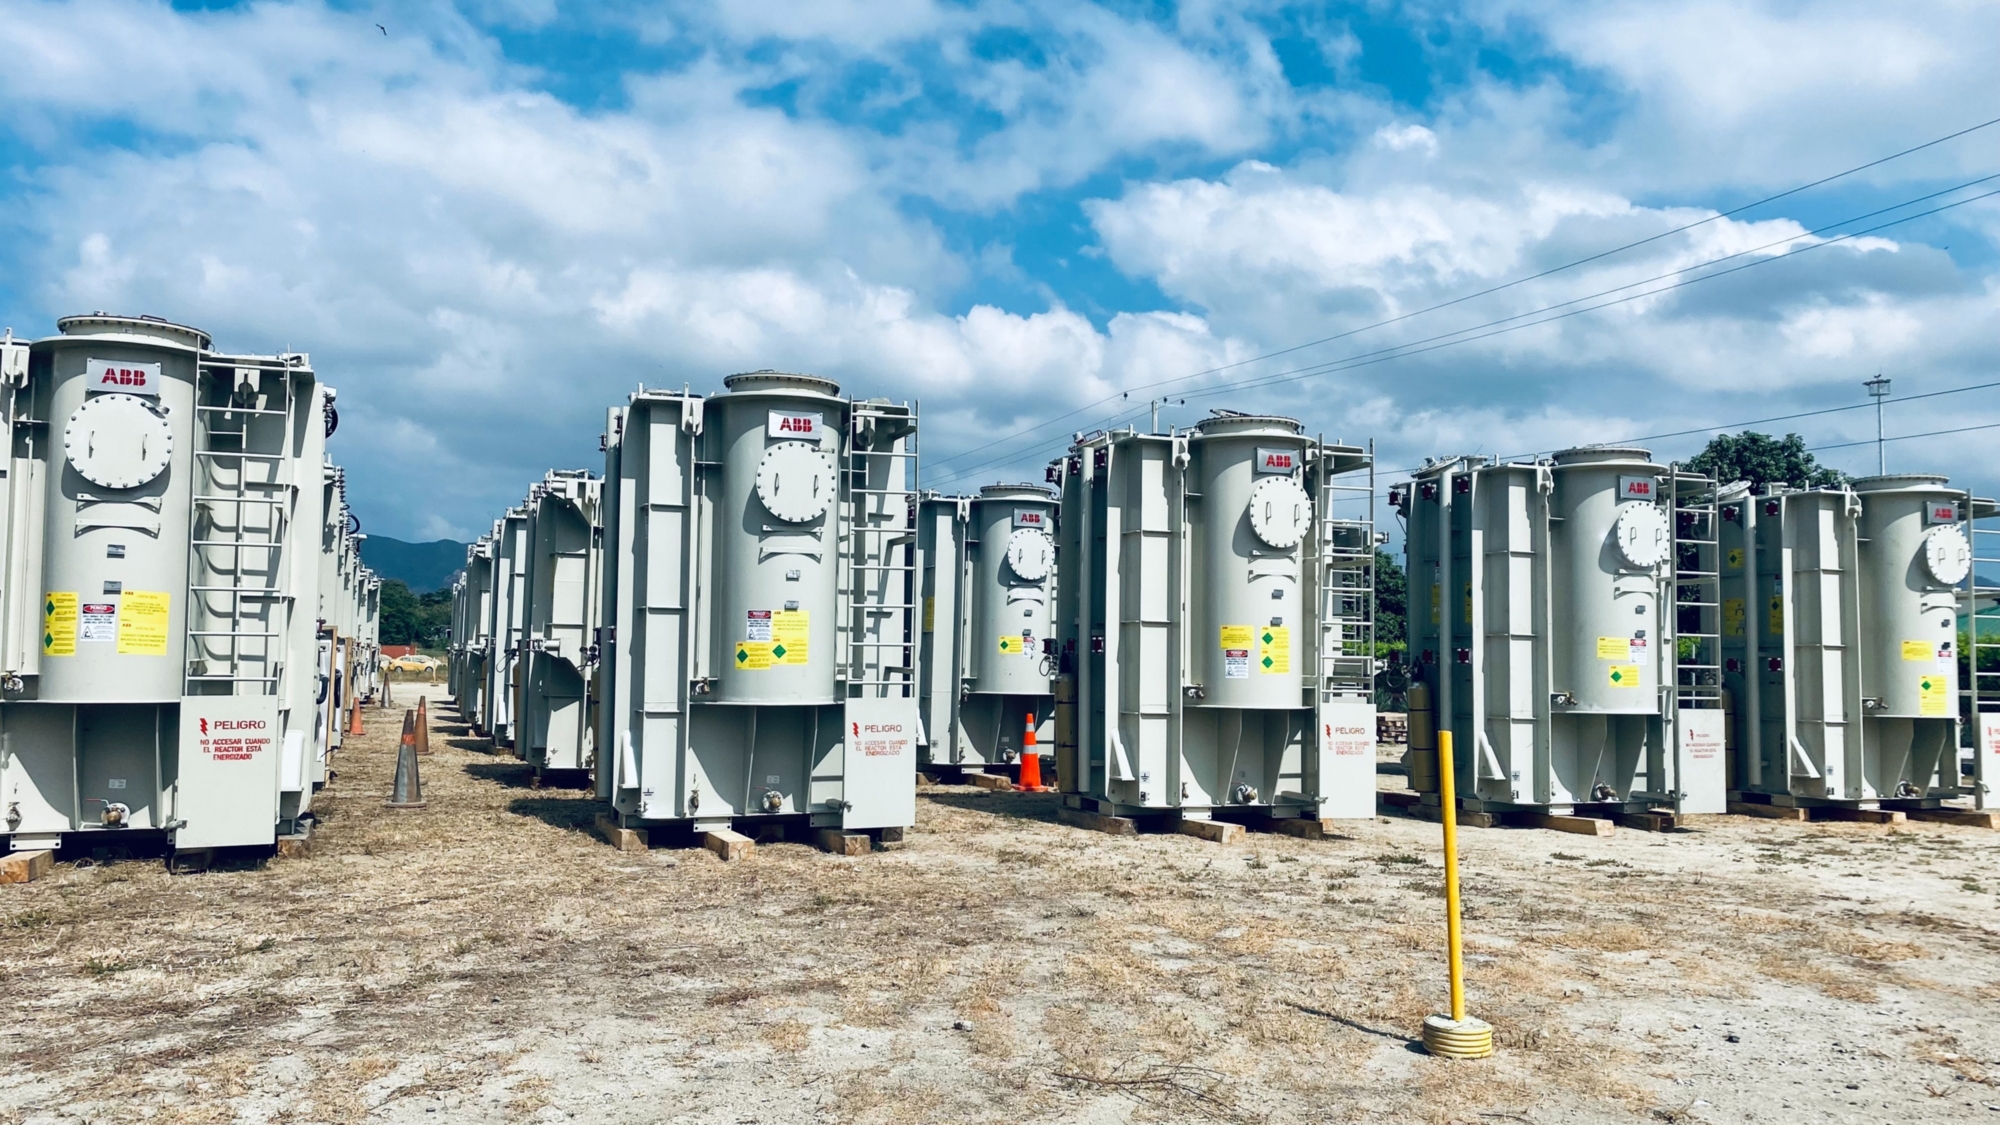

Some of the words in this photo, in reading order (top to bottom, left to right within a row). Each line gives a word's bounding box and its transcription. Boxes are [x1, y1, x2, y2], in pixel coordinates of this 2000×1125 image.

[101, 368, 146, 386] ABB
[780, 417, 812, 432] ABB
[1266, 455, 1292, 468] ABB
[1628, 482, 1650, 494] ABB
[1021, 513, 1040, 523] ABB
[1934, 508, 1952, 518] ABB
[214, 720, 266, 730] PELIGRO
[865, 724, 903, 733] PELIGRO
[1335, 727, 1365, 735] PELIGRO
[246, 744, 262, 752] ESTÁ
[213, 753, 253, 761] ENERGIZADO
